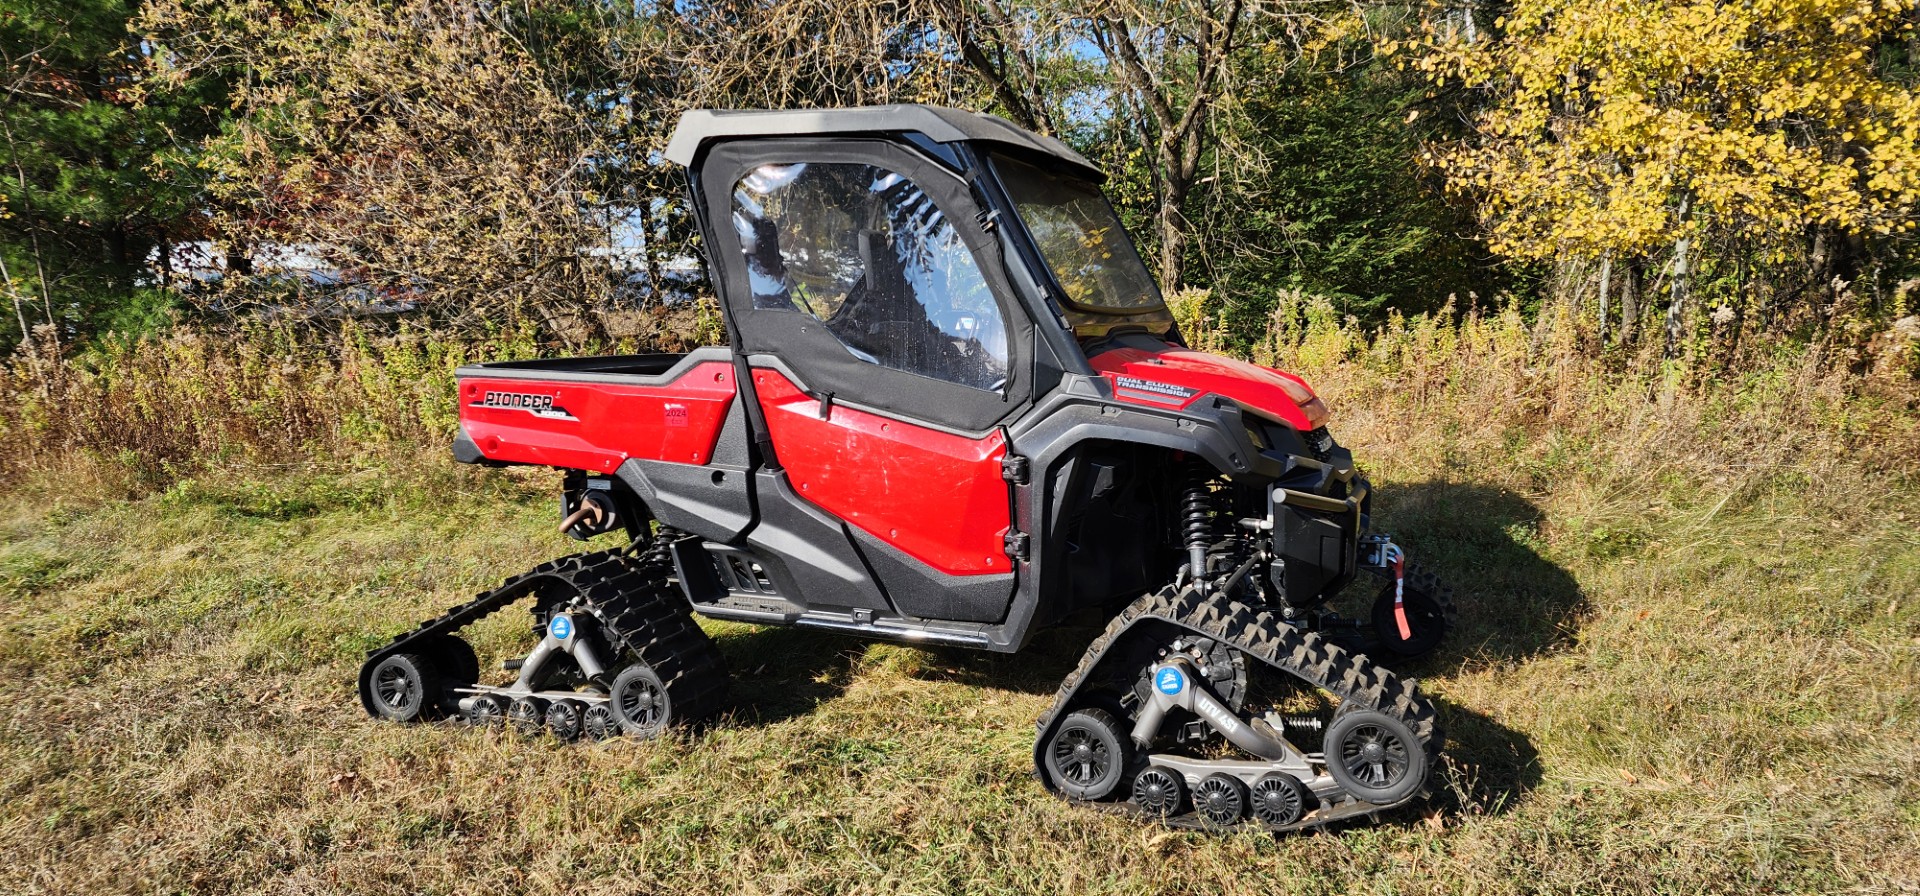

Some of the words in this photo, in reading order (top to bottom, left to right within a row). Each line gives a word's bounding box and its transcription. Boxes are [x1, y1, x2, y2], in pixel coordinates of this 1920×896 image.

[1116, 376, 1142, 385] DUAL
[1145, 380, 1184, 391] CLUTCH
[1117, 381, 1191, 398] TRANSMISSION
[484, 391, 552, 410] PIONEER
[665, 409, 686, 417] 2024
[1199, 697, 1221, 717] UTV
